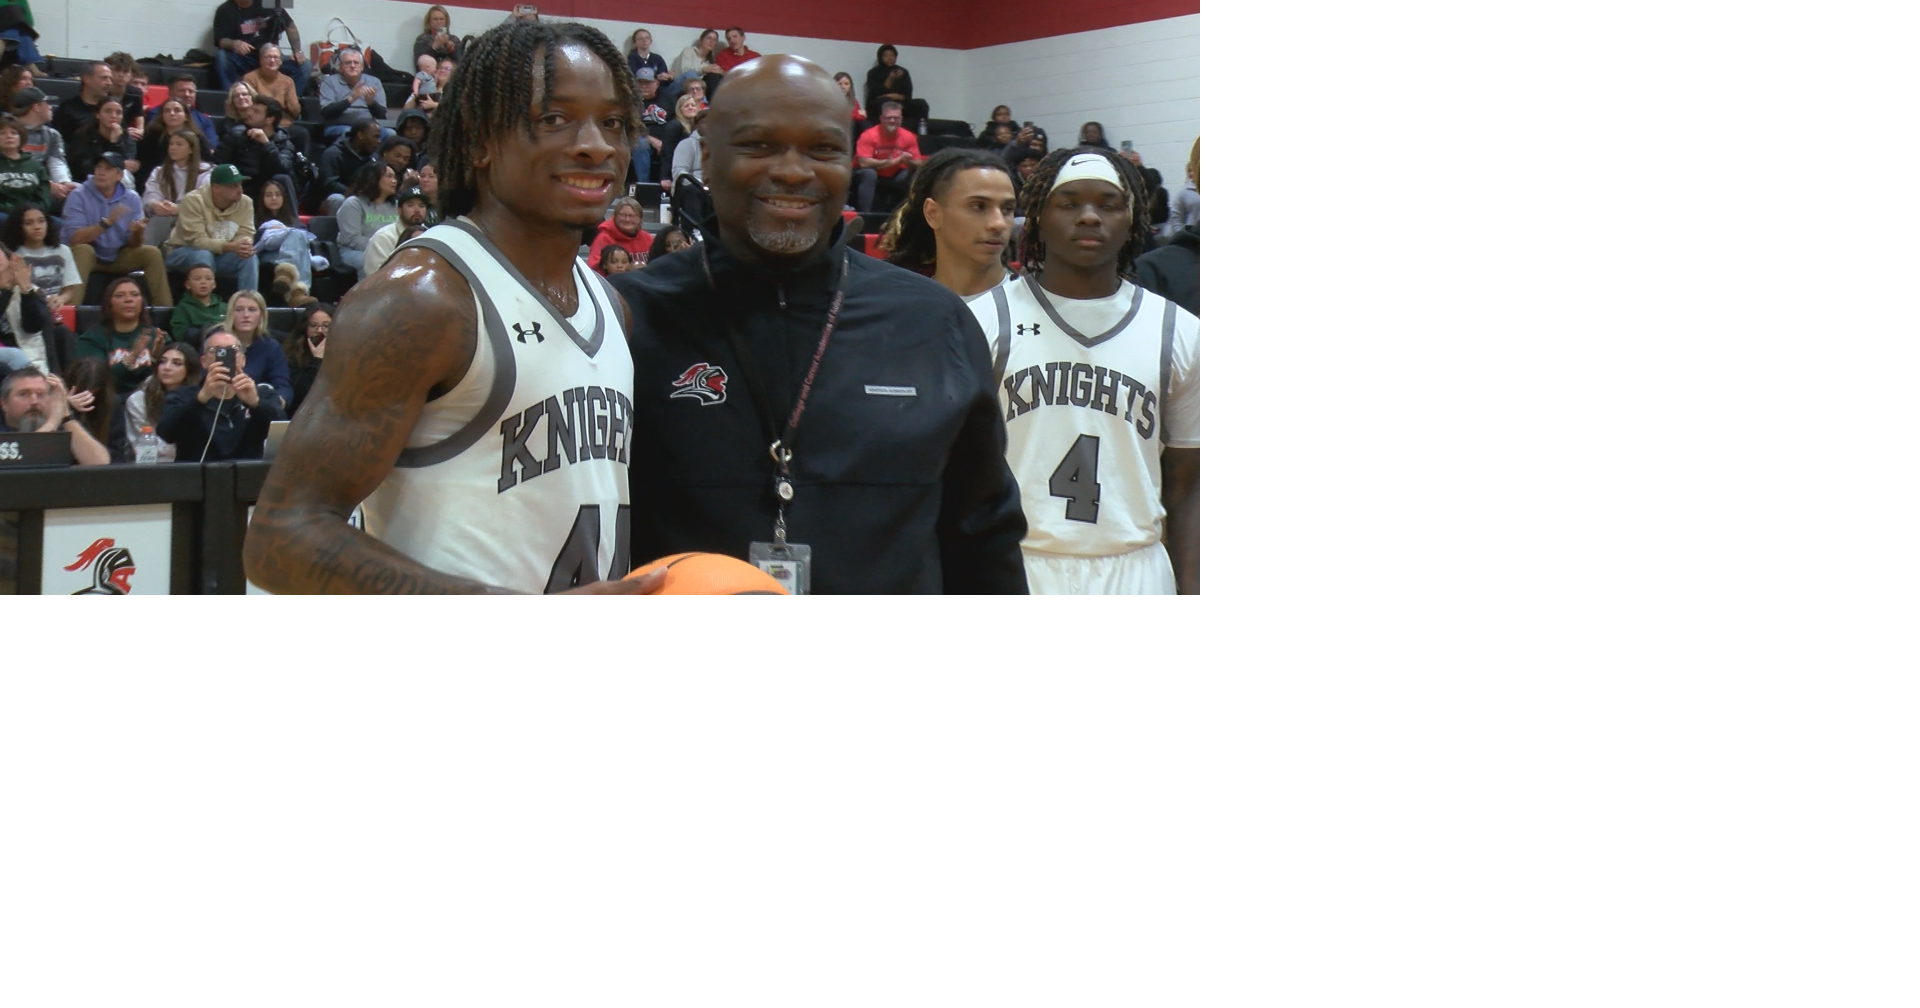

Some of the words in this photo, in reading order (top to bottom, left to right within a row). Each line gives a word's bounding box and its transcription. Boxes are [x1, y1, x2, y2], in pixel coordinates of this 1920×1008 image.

[789, 399, 805, 428] College
[805, 361, 818, 385] Career
[814, 323, 832, 361] Academies
[1004, 362, 1156, 440] KNIGHTS
[1049, 433, 1101, 525] 4
